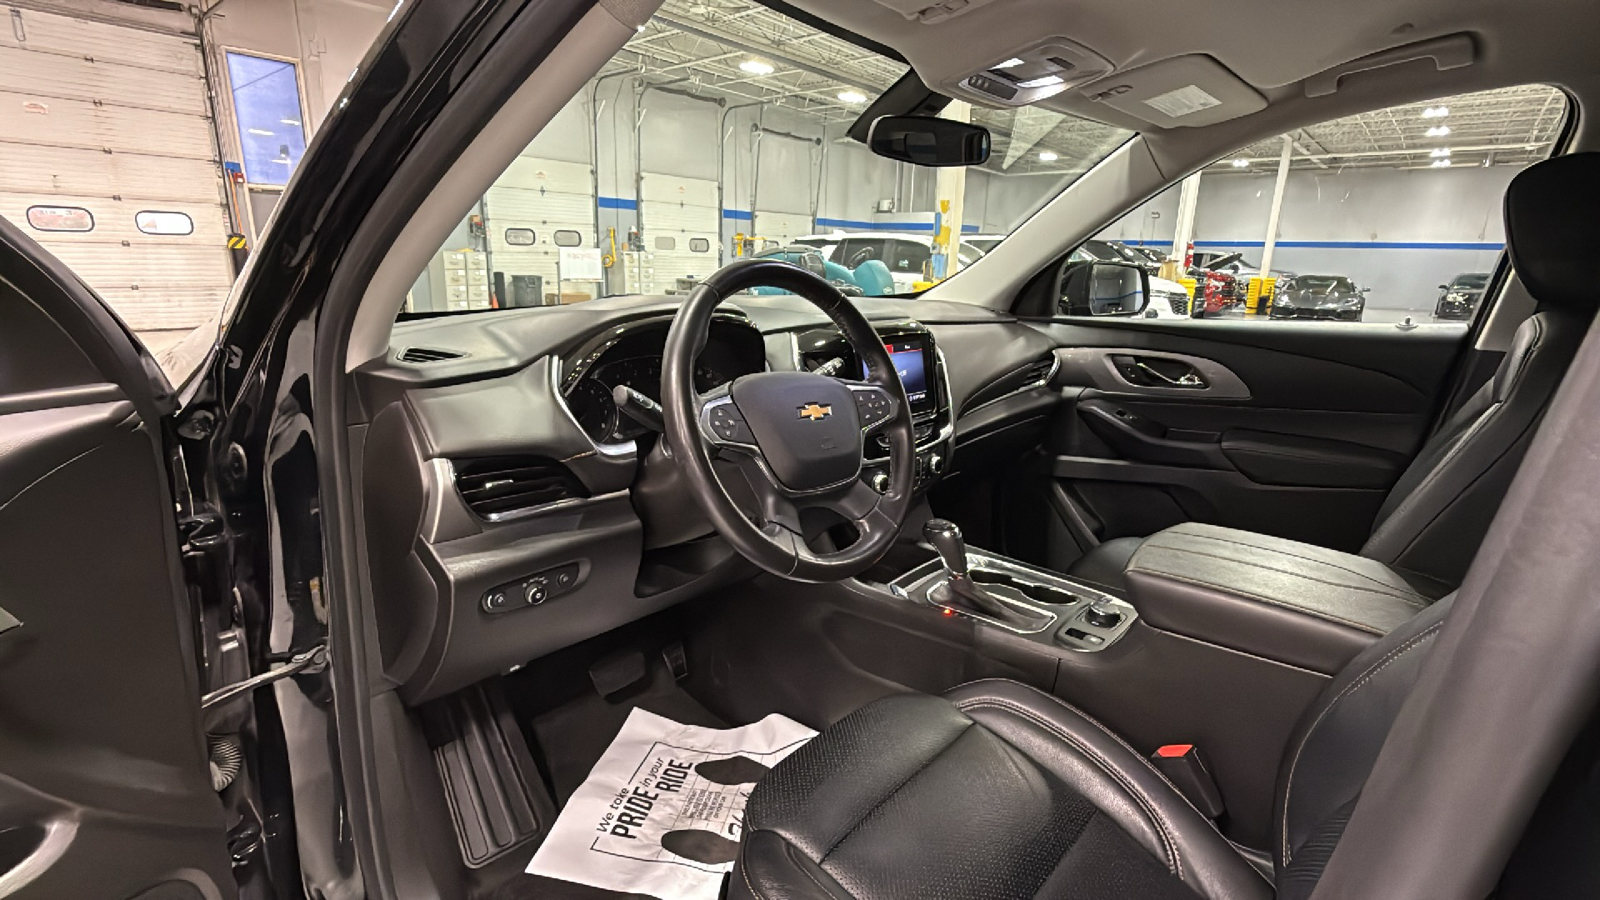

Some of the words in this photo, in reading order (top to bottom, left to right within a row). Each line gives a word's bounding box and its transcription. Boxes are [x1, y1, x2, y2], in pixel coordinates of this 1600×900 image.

[609, 786, 660, 839] PRIDE
[639, 776, 653, 788] in
[647, 757, 665, 780] your
[654, 759, 694, 793] RIDE
[596, 812, 615, 833] We
[609, 787, 630, 810] take
